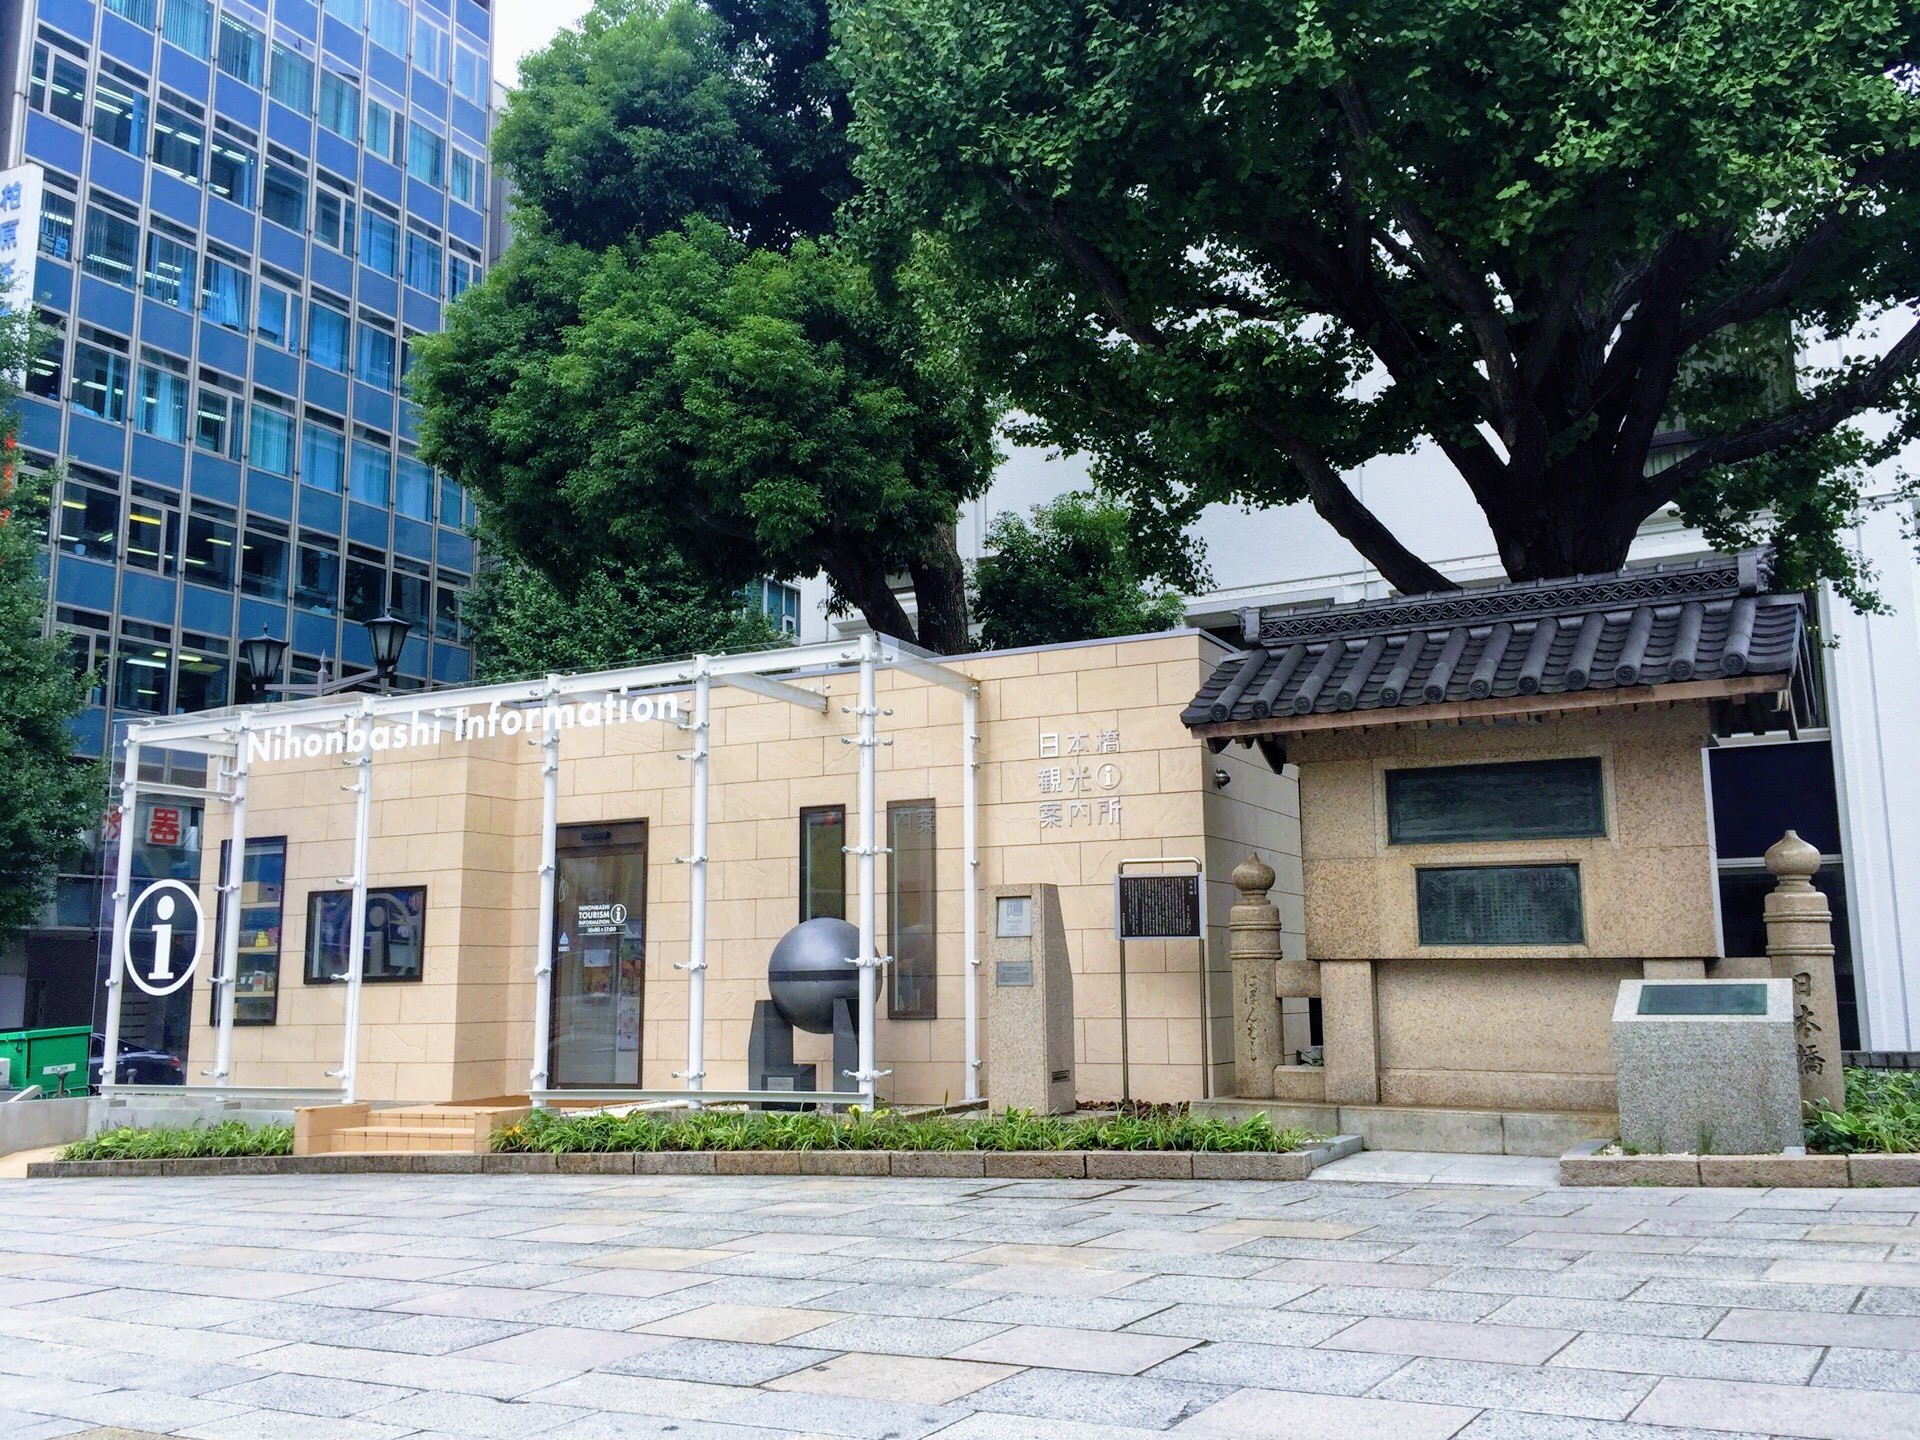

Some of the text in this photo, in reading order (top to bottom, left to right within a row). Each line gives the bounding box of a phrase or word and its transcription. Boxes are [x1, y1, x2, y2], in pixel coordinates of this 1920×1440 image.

[247, 686, 678, 763] Nihonbashi Information
[1040, 730, 1120, 757] 日本橋
[1039, 766, 1091, 793] 観光
[1040, 798, 1121, 828] 案内所
[579, 911, 610, 919] TOURISM
